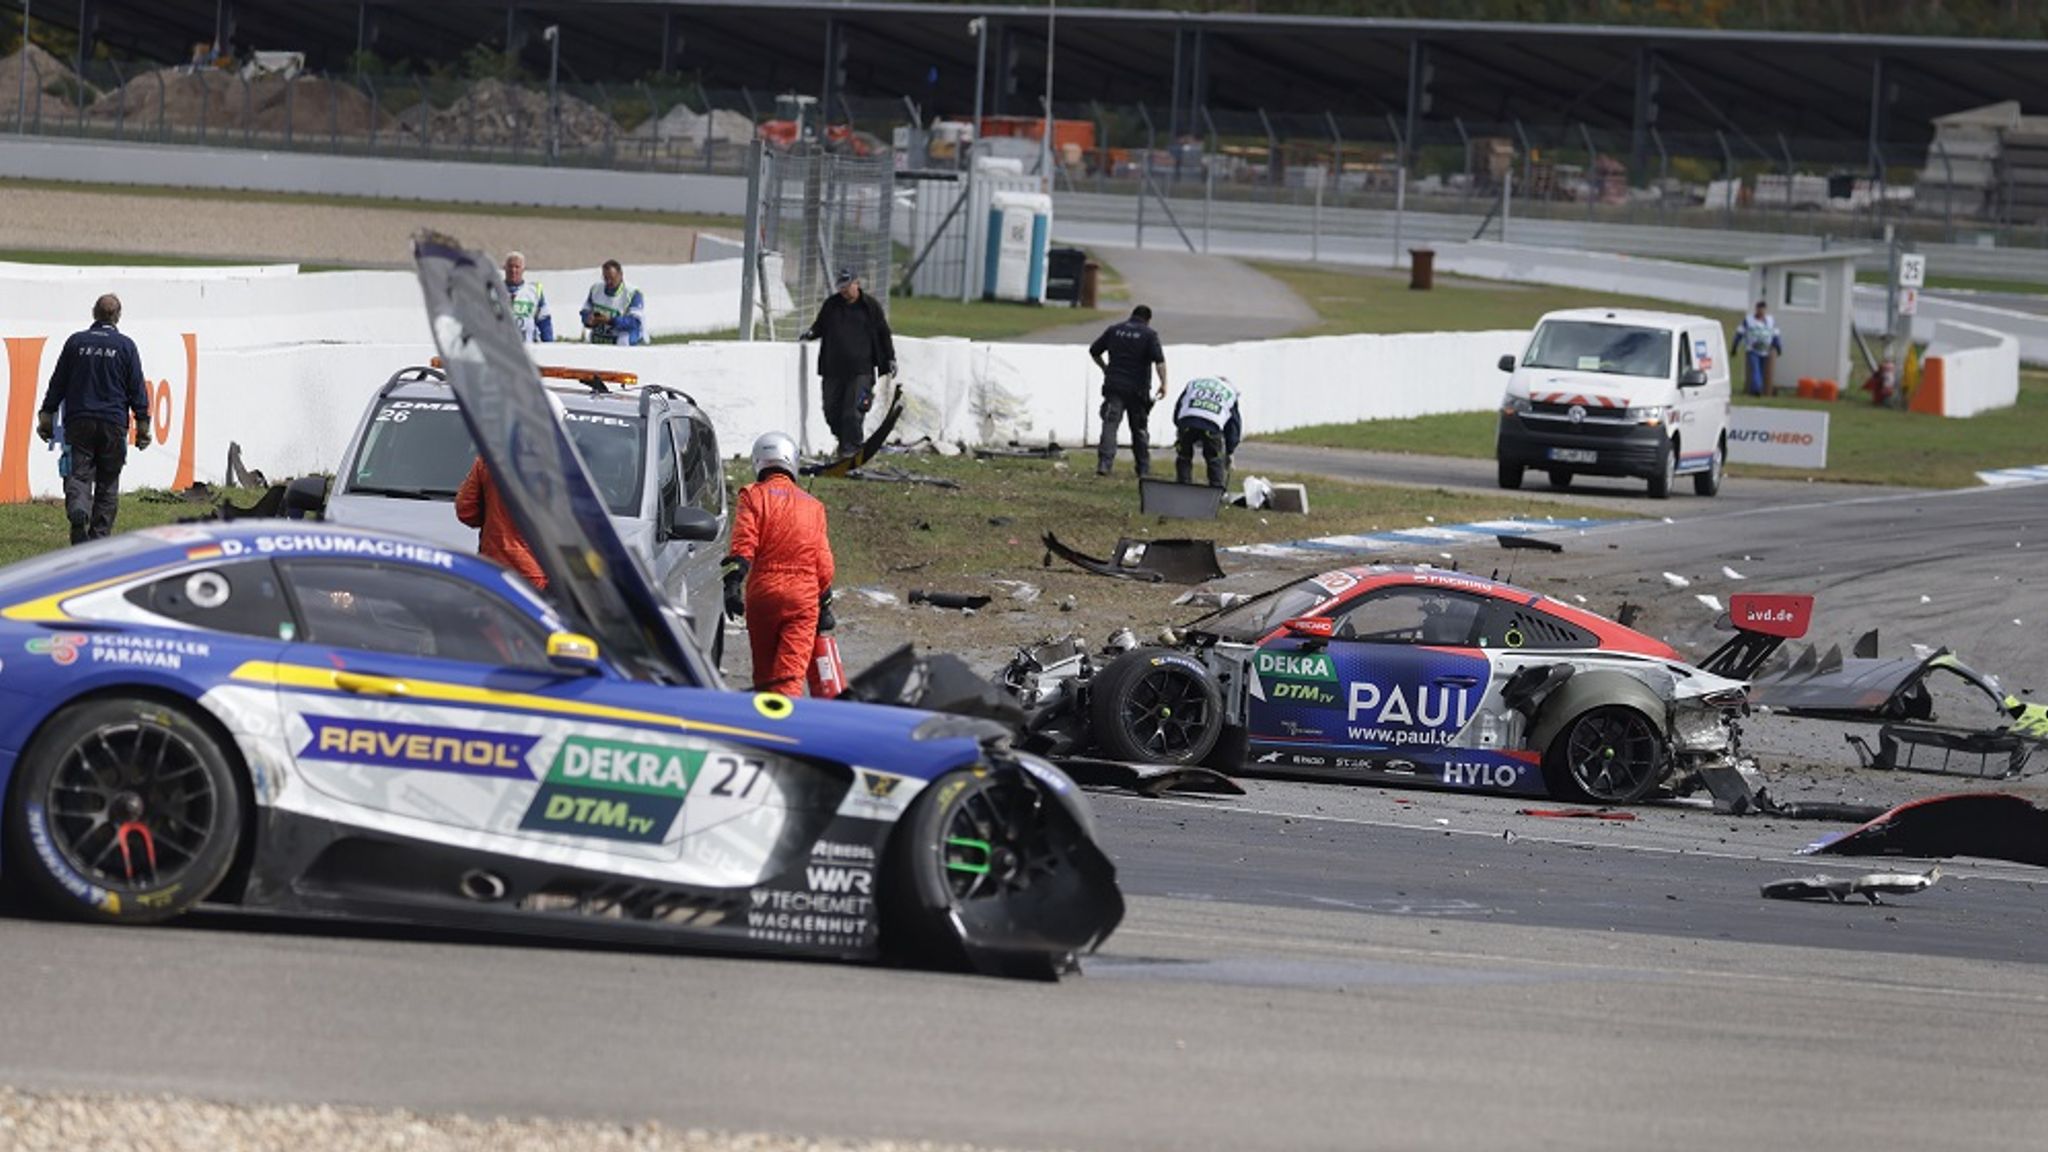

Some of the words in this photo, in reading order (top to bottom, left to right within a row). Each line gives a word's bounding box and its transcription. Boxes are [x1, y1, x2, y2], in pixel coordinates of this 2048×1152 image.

[1904, 261, 1920, 280] 25
[78, 346, 117, 358] TEAM
[375, 409, 411, 423] 26
[1728, 429, 1813, 446] AUTOHERO
[221, 539, 250, 556] D.
[255, 535, 453, 568] SCHUMACHER
[1747, 609, 1794, 622] avd.de
[92, 634, 209, 656] SCHAEFFLER
[92, 646, 181, 669] PARAVAN
[1260, 654, 1329, 677] DEKRA
[1273, 683, 1319, 700] DTM
[1348, 681, 1468, 728] PAUL
[319, 726, 519, 768] RAVENOL
[563, 744, 688, 791] DEKRA
[710, 757, 765, 798] 27
[544, 794, 629, 828] DTM
[627, 817, 655, 834] TV
[771, 890, 872, 915] TECHEMET
[748, 912, 868, 934] WACKENHUT
